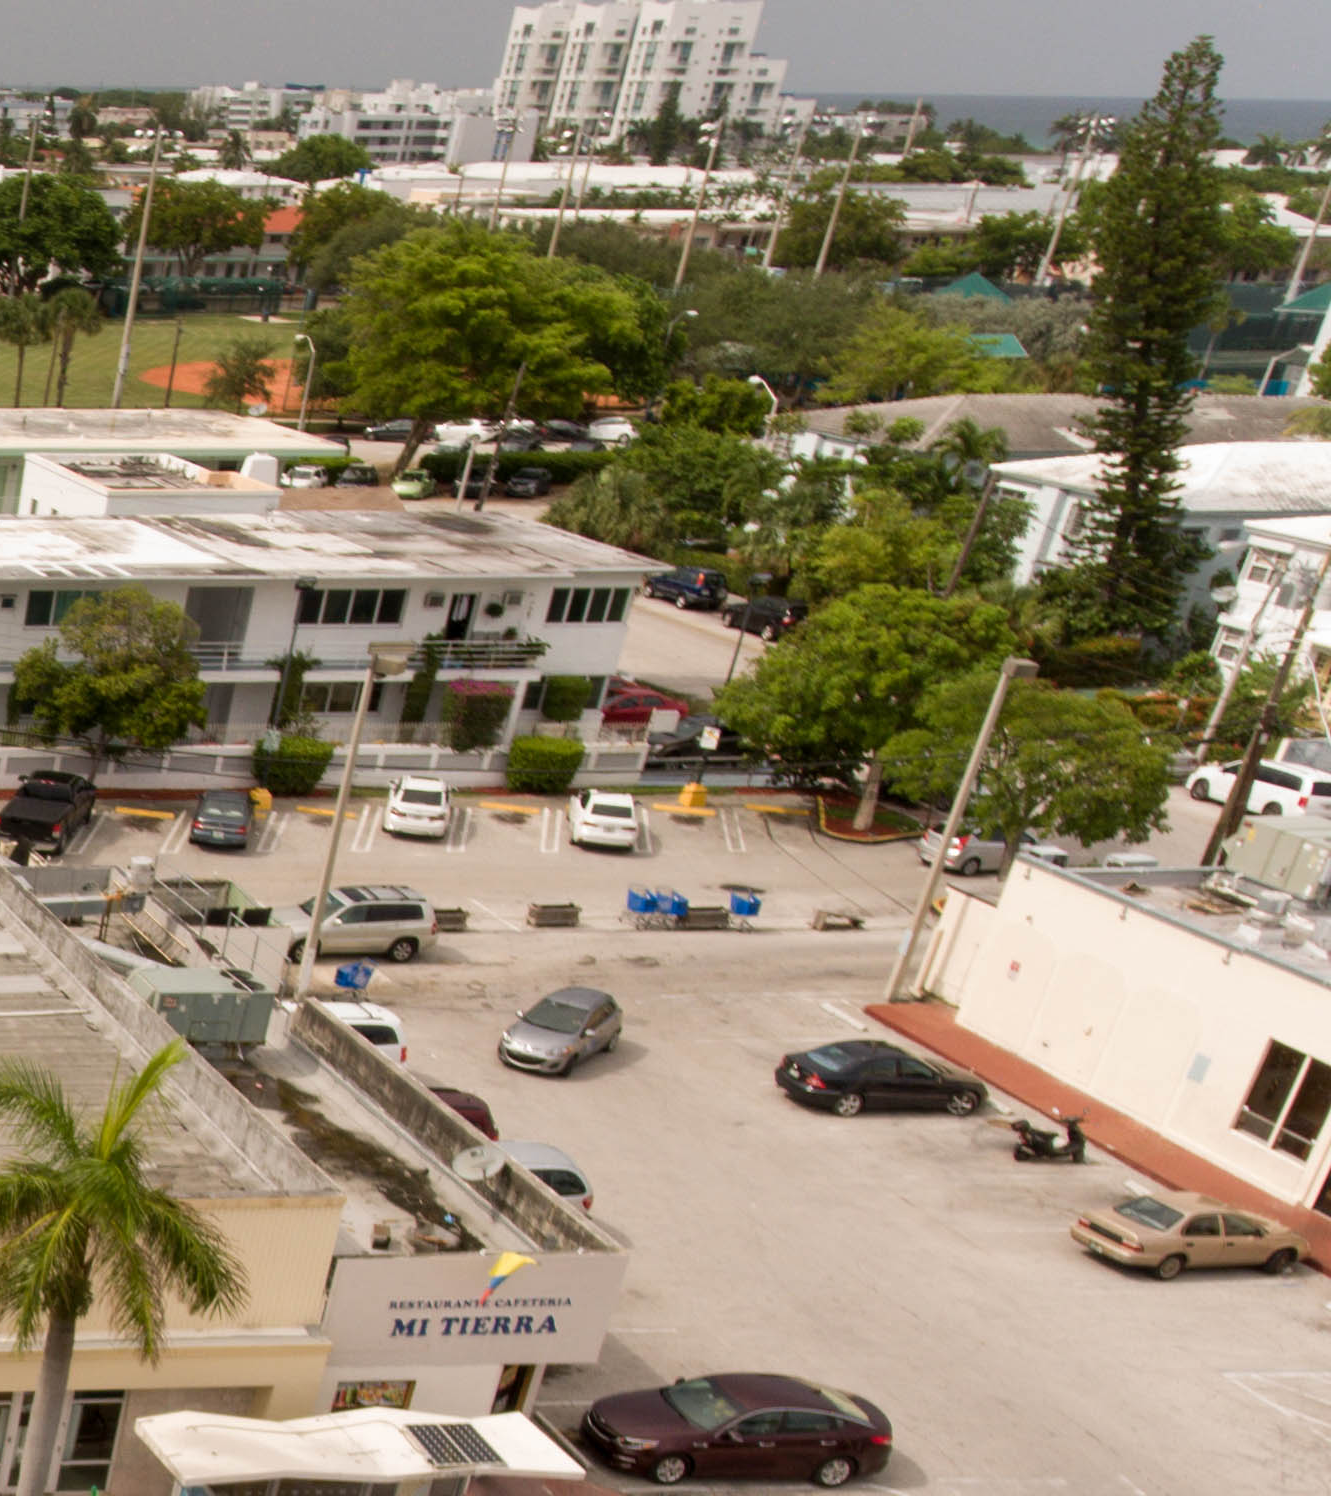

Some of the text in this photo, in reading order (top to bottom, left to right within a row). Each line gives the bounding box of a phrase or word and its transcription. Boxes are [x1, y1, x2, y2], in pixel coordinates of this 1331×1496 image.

[389, 1297, 572, 1310] RESTAURANTE CAFETERIA
[391, 1315, 557, 1337] MI TIERRA
